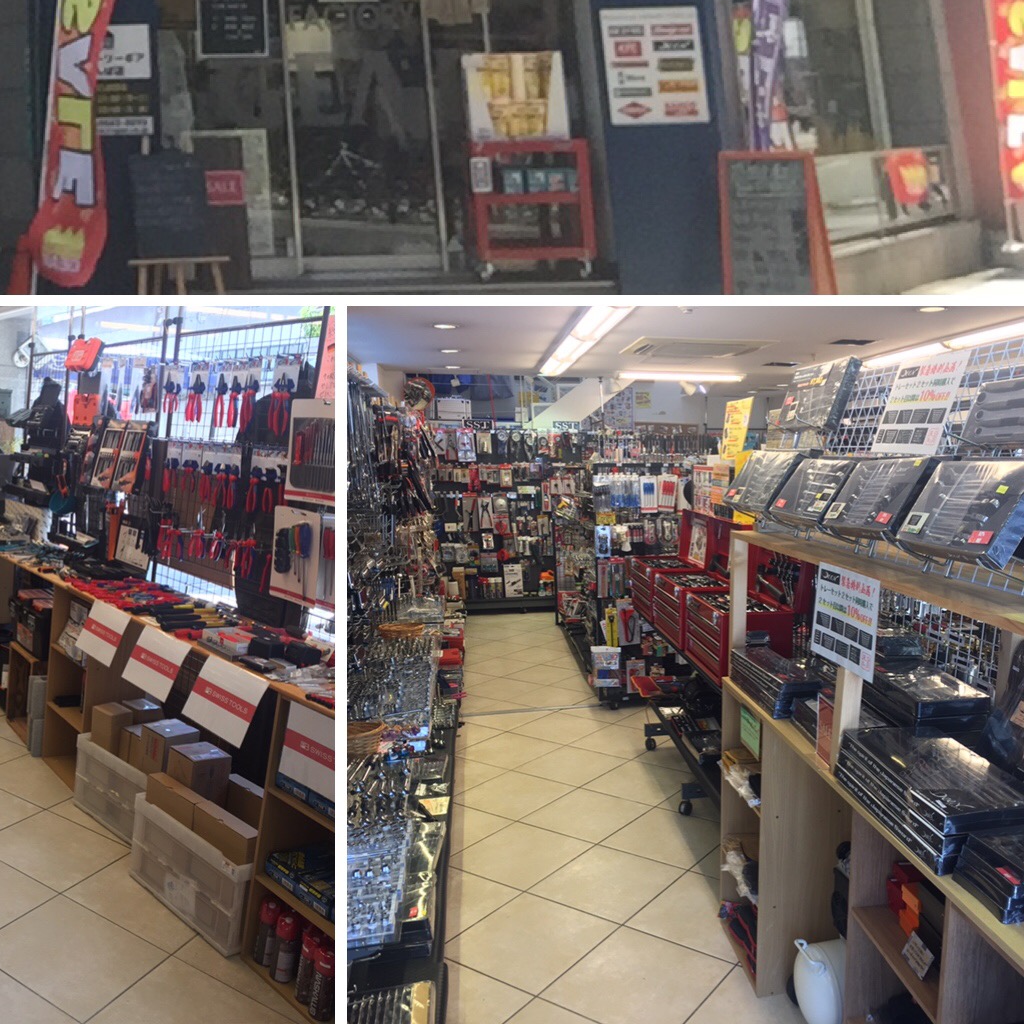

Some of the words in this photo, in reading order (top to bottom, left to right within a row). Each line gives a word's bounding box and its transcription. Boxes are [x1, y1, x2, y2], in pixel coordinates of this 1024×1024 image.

[466, 420, 490, 428] SST
[145, 655, 159, 667] SWISS
[158, 661, 174, 674] TOOLS
[212, 690, 230, 703] SWISS
[228, 700, 249, 714] TOOLS
[310, 745, 333, 763] SWISS
